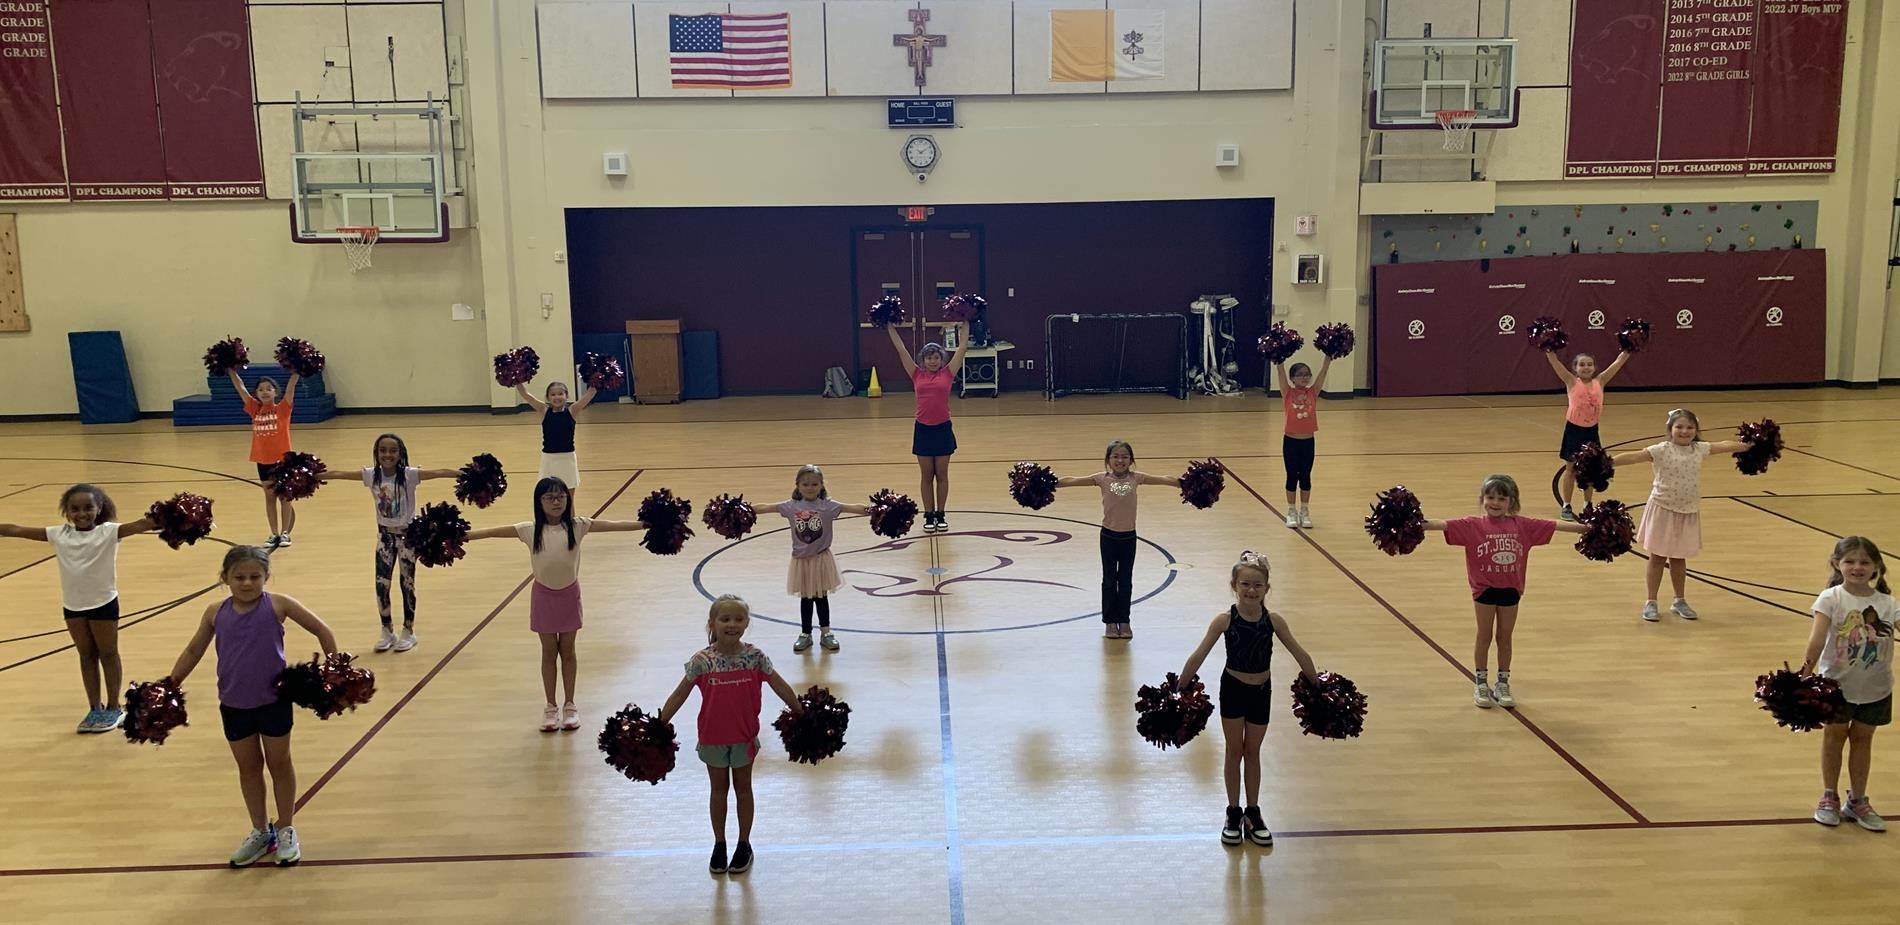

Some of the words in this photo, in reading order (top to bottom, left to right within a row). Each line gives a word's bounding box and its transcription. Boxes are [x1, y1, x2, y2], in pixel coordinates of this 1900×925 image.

[0, 3, 43, 12] GRADE
[1671, 0, 1693, 8] 2013
[1764, 4, 1785, 13] 2022
[1787, 4, 1800, 13] JV
[1801, 4, 1821, 15] Boys
[1822, 4, 1842, 13] MVP
[0, 17, 44, 27] GRADE
[1670, 14, 1693, 24] 2014
[1695, 13, 1711, 23] 5TH
[1712, 12, 1753, 22] GRADE
[2, 32, 47, 42] GRADE
[1670, 29, 1692, 38] 2016
[1695, 28, 1710, 37] 7TH
[1711, 27, 1752, 36] GRADE
[1669, 43, 1691, 52] 2016
[1693, 42, 1709, 52] 8TH
[1711, 41, 1751, 51] GRADE
[3, 47, 47, 57] GRADE
[1668, 57, 1690, 67] 2017
[1693, 56, 1728, 66] CO-ED
[1667, 72, 1684, 81] 2022
[1696, 71, 1725, 81] GRADE
[1726, 70, 1750, 80] GIRLS
[1569, 166, 1589, 174] DPL
[1591, 165, 1652, 174] CHAMPIONS
[1660, 165, 1680, 173] DPL
[1683, 163, 1743, 172] CHAMPIONS
[1749, 163, 1769, 171] DPL
[1772, 162, 1833, 171] CHAMPIONS
[0, 188, 64, 196] CHAMPIONS
[76, 188, 98, 196] DPL
[99, 187, 163, 196] CHAMPIONS
[172, 187, 194, 195] DPL
[197, 186, 260, 195] CHAMPIONS
[908, 207, 924, 219] EXIT
